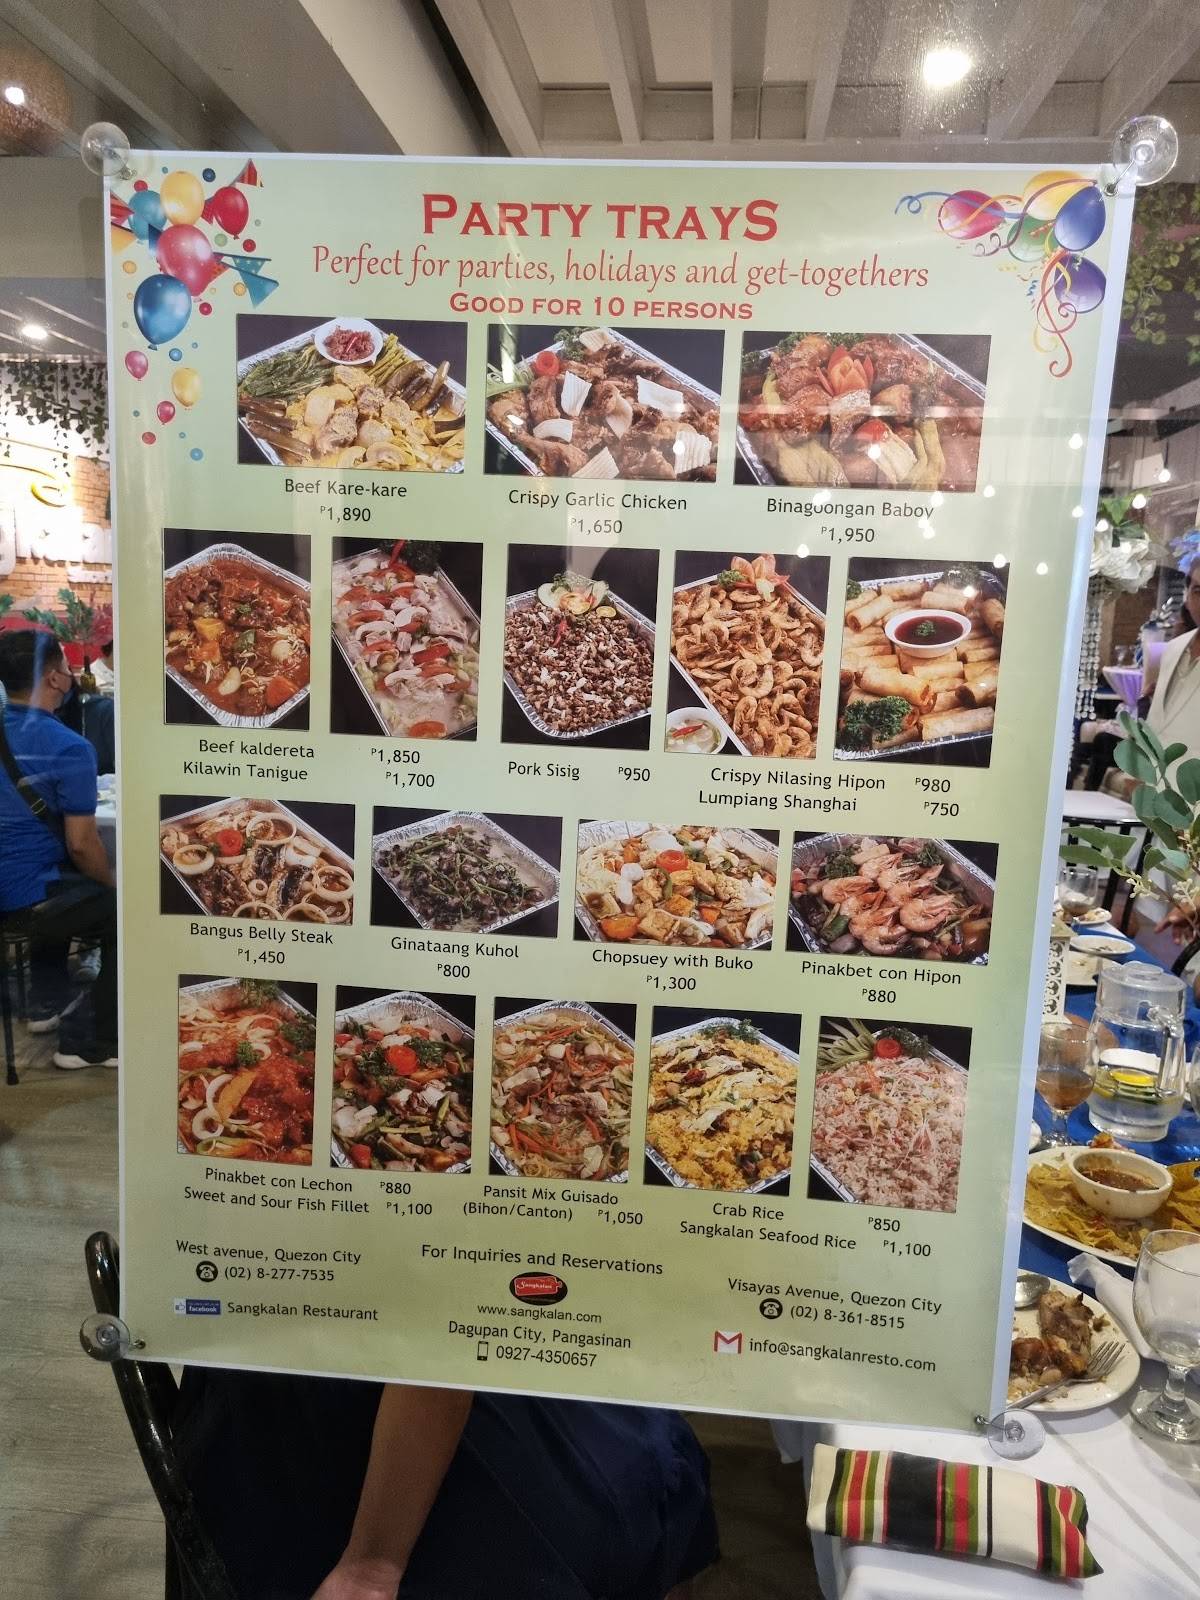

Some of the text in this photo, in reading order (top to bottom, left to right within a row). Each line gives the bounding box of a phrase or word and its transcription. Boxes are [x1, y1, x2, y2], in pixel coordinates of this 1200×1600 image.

[422, 193, 779, 242] PARTY TRAYS
[312, 242, 929, 297] Perfect for parties, holidays and get-togethers
[449, 292, 753, 320] GOOD FOR 10 PERSONS
[284, 478, 408, 498] Beef Kare-kare
[508, 489, 687, 510] Crispy Garlic Chicken
[767, 497, 934, 519] Binagoongan Baboy
[199, 739, 315, 759] Beef kaldereta
[183, 761, 308, 783] Kilawin Tanigue
[508, 761, 580, 781] Pork Sisig
[710, 767, 885, 792] Crispy Nilasing Hipon
[699, 790, 857, 813] Lumpiang Shanghai
[190, 922, 334, 945] Bangus Belly Steak
[390, 936, 519, 958] Ginataang Kuhol
[592, 949, 754, 970] Chopsuey with Buko
[801, 960, 961, 986] Pinakbet con Hipon
[205, 1167, 353, 1192] Pinakbet con Lechon
[184, 1186, 370, 1214] Sweet and Sour Fish Fillet
[483, 1185, 619, 1205] Pansit Mix Guisado
[463, 1201, 573, 1223] (Bihon/Canton)
[712, 1202, 785, 1221] Crab Rice
[679, 1220, 857, 1250] Sangkalan Seafood Rice
[175, 1239, 362, 1266] West avenue, Quezon City
[422, 1244, 663, 1275] For Inquiries and Reservations
[224, 1266, 335, 1282] (02) 8-277-7535
[727, 1277, 942, 1316] Visayas Avenue, Quezon City
[227, 1301, 379, 1321] Sangkalan Restaurant
[476, 1304, 602, 1324] www.sangkalan.com
[790, 1305, 905, 1329] (02) 8-361-8515
[448, 1320, 631, 1348] Dagupan City, Pangasinan
[495, 1345, 598, 1367] 0927-4350657
[748, 1337, 936, 1372] info@sangkalanresto.com
